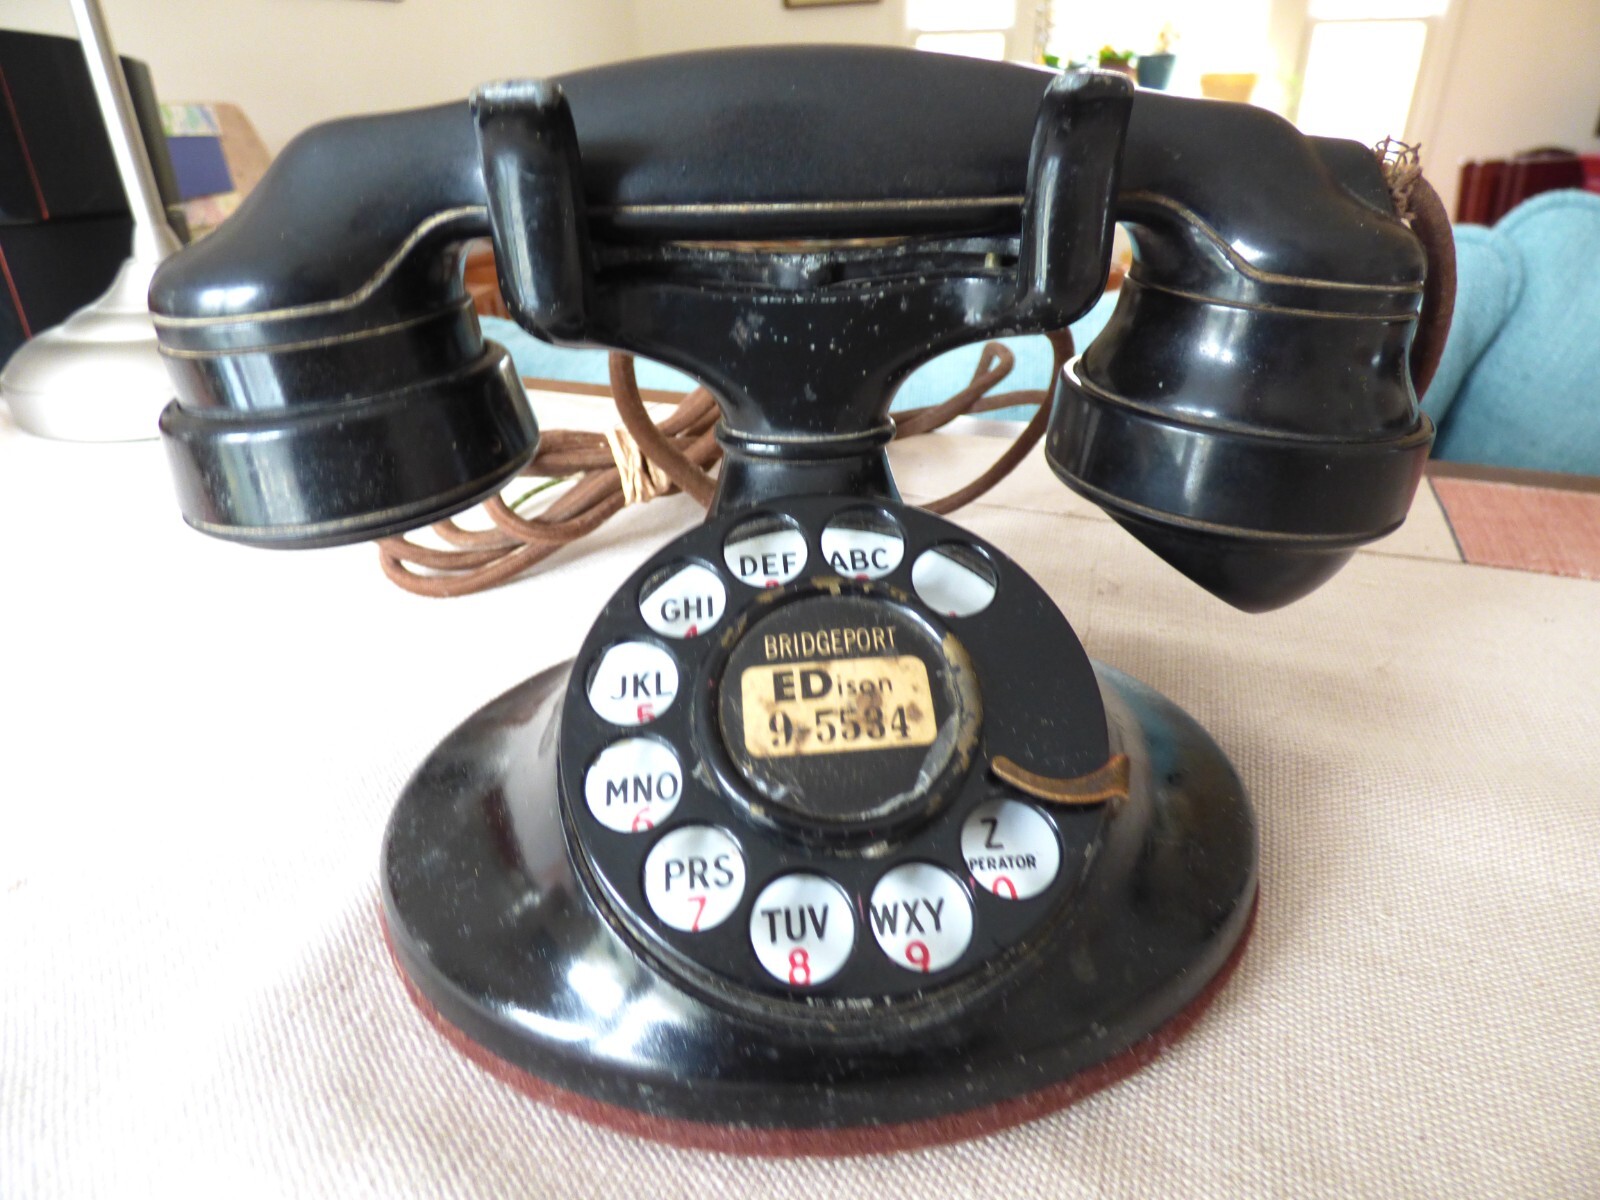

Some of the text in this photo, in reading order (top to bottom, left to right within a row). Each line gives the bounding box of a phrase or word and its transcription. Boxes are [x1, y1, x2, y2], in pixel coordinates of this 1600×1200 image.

[739, 552, 797, 577] DEF
[829, 548, 890, 573] ABC
[660, 595, 715, 622] GHI
[764, 625, 896, 661] BRIDGEPORT
[611, 670, 673, 700] JKL
[772, 668, 893, 702] EDison
[605, 771, 679, 806] MNO
[980, 816, 1004, 849] Z
[664, 854, 735, 892] PRS
[967, 853, 1037, 871] PERATOR
[688, 896, 706, 932] 7
[761, 903, 829, 944] TUV
[870, 897, 944, 936] WXY
[788, 946, 811, 986] 8
[905, 939, 930, 973] 9
